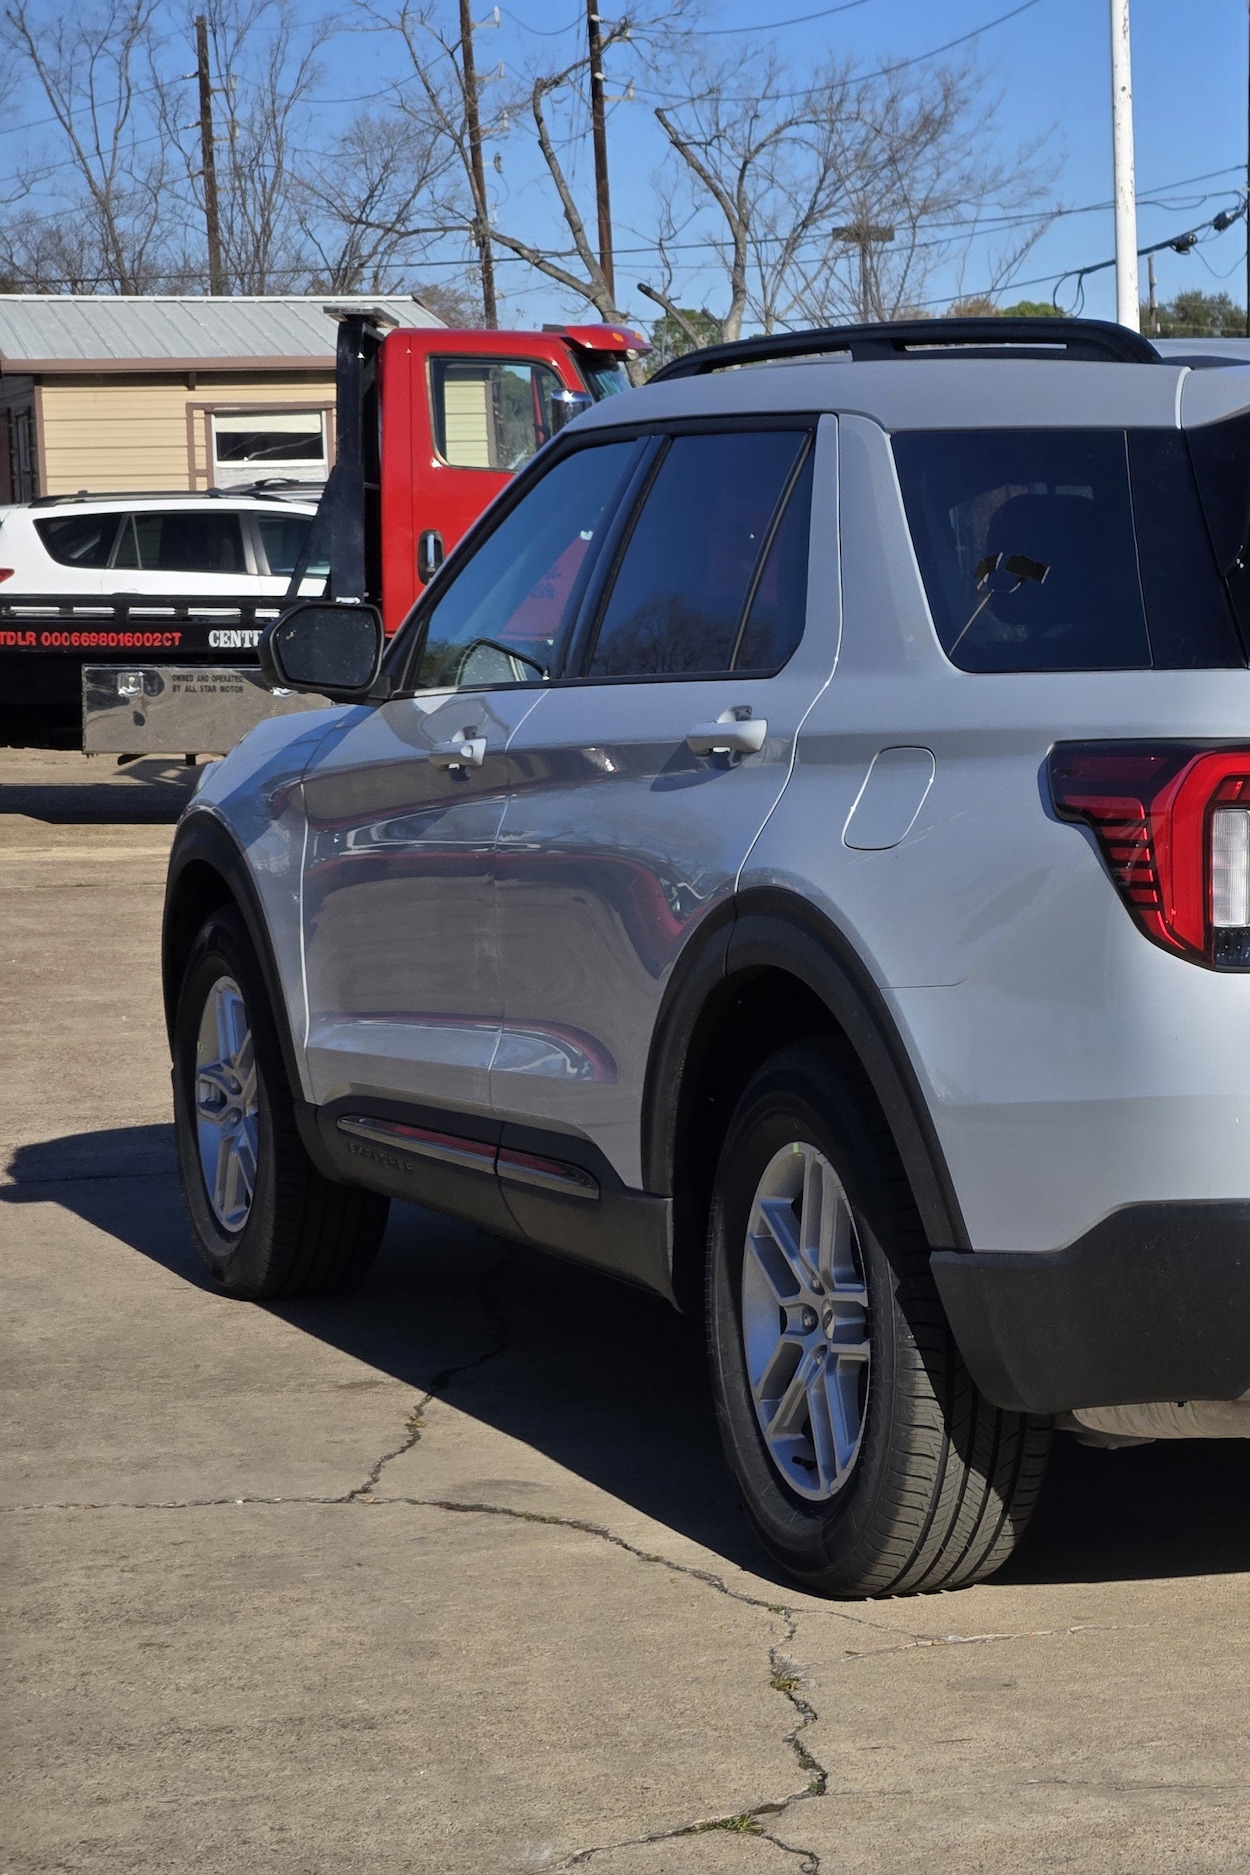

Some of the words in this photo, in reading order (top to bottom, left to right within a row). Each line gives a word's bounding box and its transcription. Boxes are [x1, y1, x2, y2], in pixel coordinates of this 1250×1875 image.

[0, 630, 36, 646] TDLR
[41, 631, 182, 647] 0006698016002CT
[172, 674, 194, 682] OWNED
[197, 674, 209, 682] AND
[211, 674, 244, 683] OPERATED
[172, 685, 181, 693] BY
[184, 685, 197, 693] ALL
[200, 685, 217, 693] STAR
[220, 685, 244, 693] MOTOR
